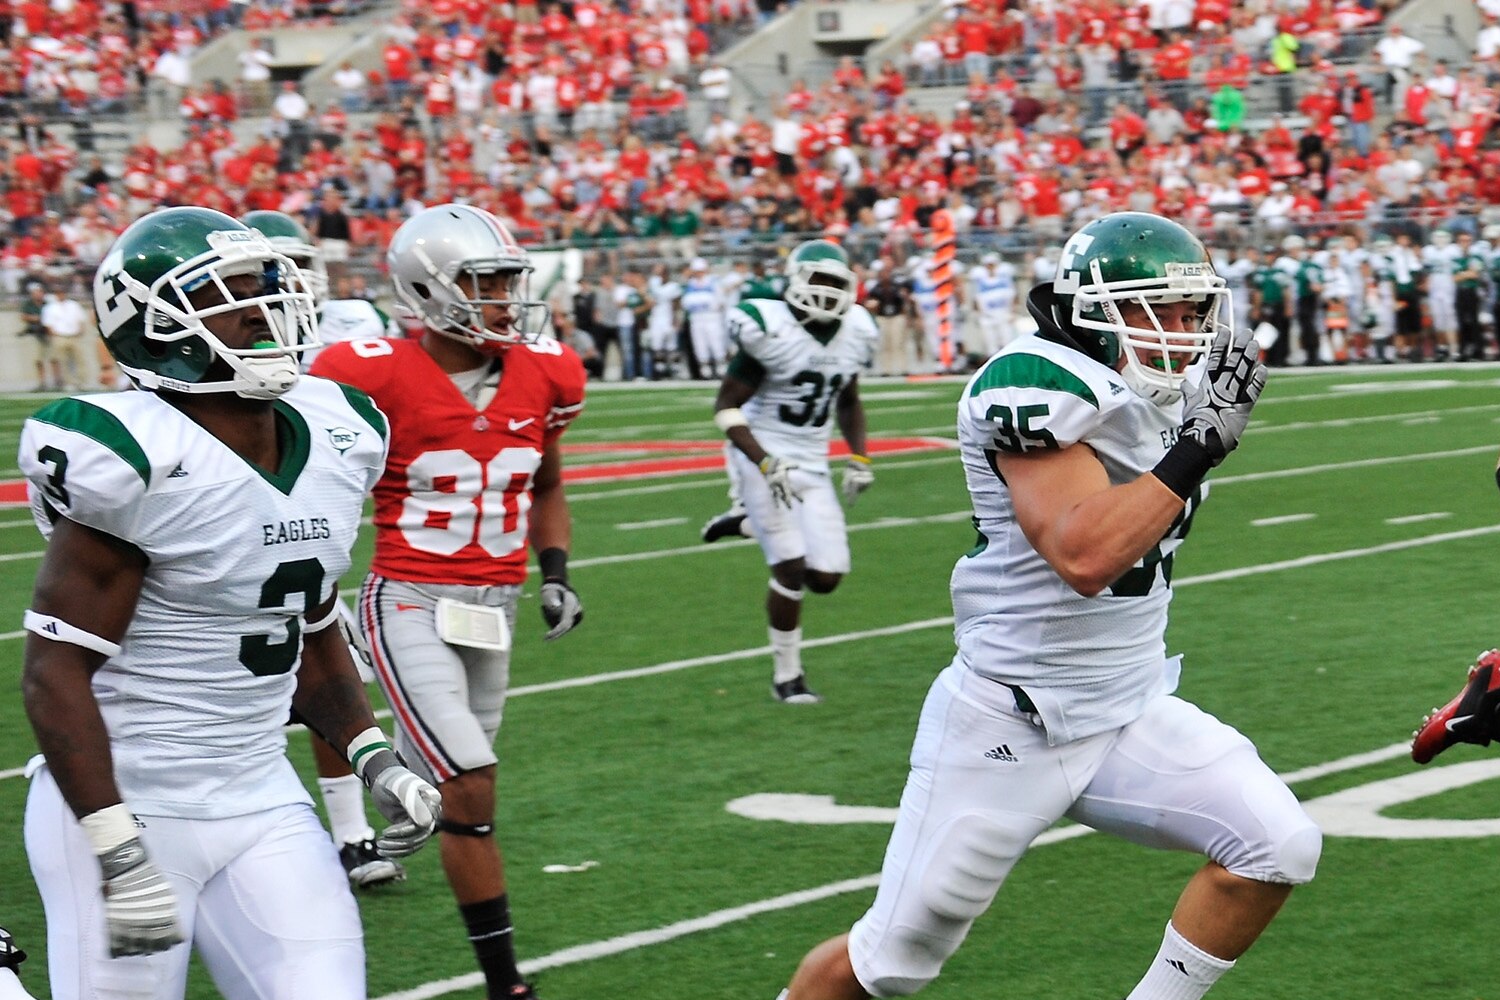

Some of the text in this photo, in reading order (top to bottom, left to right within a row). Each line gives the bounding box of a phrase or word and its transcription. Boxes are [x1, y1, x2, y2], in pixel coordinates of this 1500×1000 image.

[1053, 232, 1096, 294] E
[778, 370, 843, 418] 31
[984, 403, 1059, 454] 35
[1160, 425, 1183, 450] EAG
[38, 445, 71, 509] 3
[396, 447, 543, 558] 80
[263, 518, 331, 547] EAGLES
[238, 557, 327, 677] 3
[984, 751, 1019, 763] adidas
